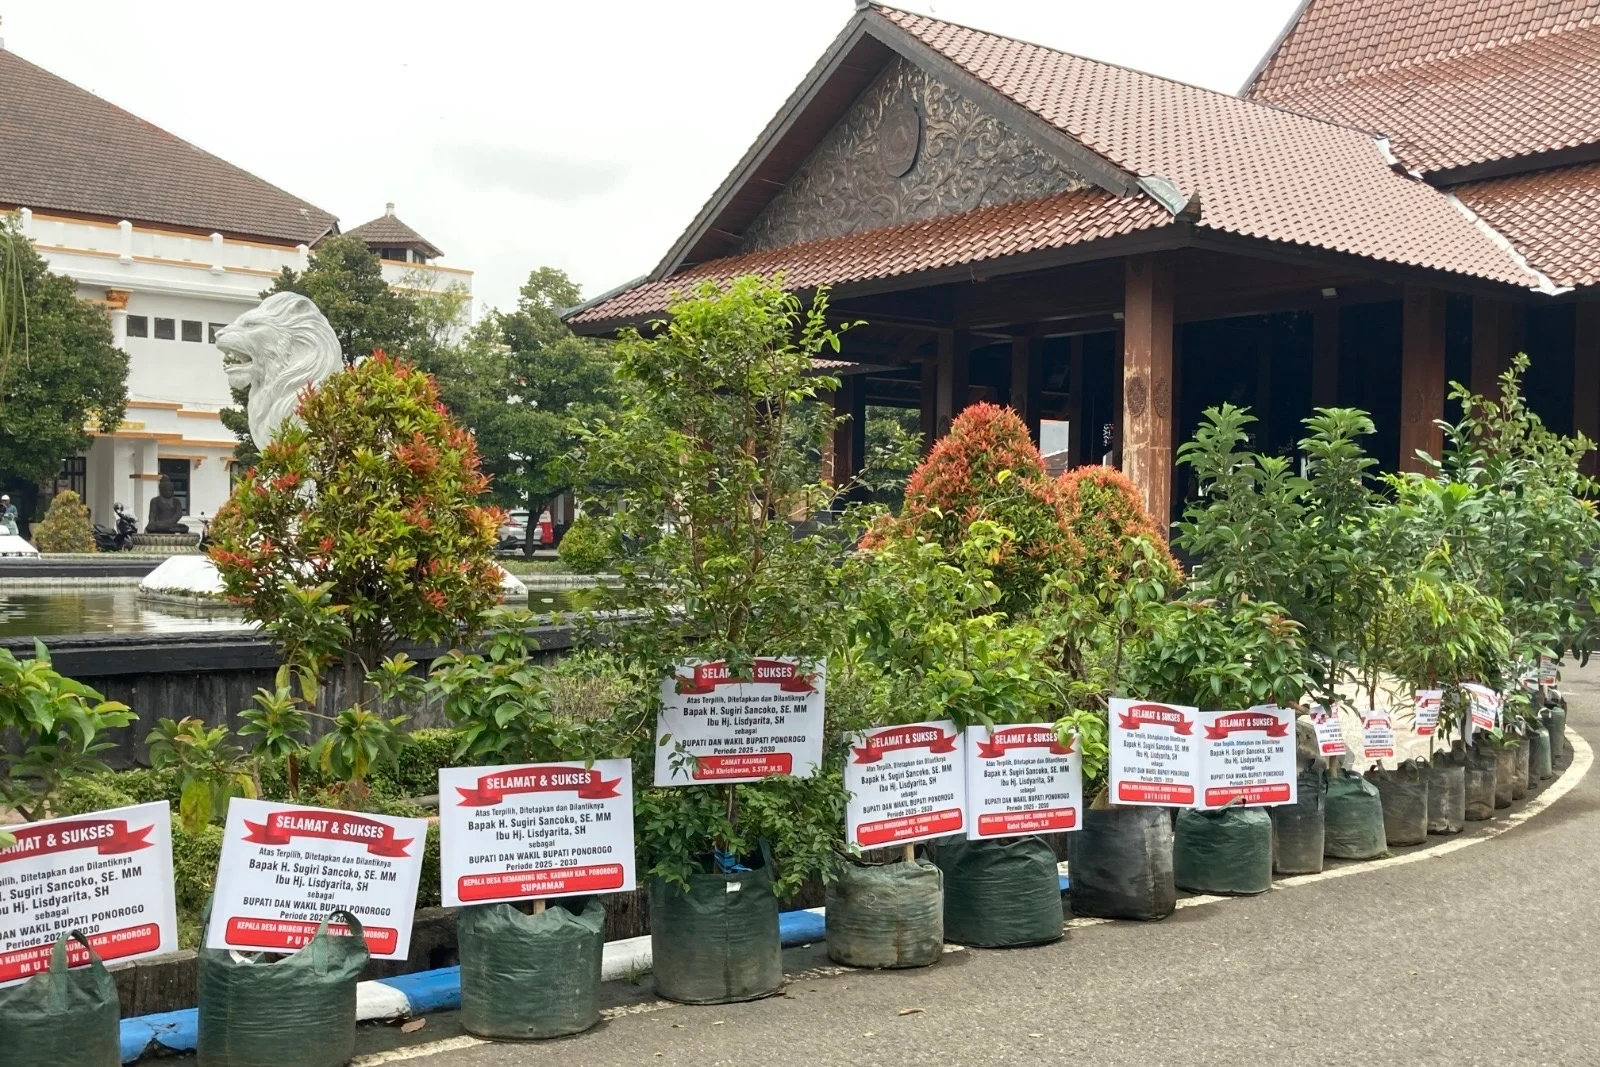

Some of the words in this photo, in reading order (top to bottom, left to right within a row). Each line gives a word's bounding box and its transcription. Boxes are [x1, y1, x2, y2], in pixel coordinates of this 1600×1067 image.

[757, 666, 792, 678] SUKSES
[701, 696, 726, 704] Terpilih,
[727, 695, 760, 703] Ditetapkan
[683, 706, 708, 717] Bapak
[710, 706, 718, 715] H.
[720, 705, 742, 717] Sugiri
[744, 705, 778, 714] Sancoko,
[780, 704, 791, 714] SE.
[793, 704, 807, 713] MM
[707, 717, 719, 726] Ibu
[721, 717, 732, 727] Hj.
[733, 716, 772, 727] Lisdyarita,
[774, 715, 785, 724] SH
[1219, 718, 1245, 728] SELAMAT
[1246, 718, 1251, 727] &
[1252, 717, 1273, 726] SUKSES
[734, 727, 757, 736] sebagai
[871, 734, 903, 748] SELAMAT
[904, 733, 910, 744] &
[912, 730, 938, 743] SUKSES
[994, 733, 1025, 744] SELAMAT
[1026, 733, 1032, 743] &
[1033, 732, 1058, 742] SUKSES
[681, 739, 706, 748] BUPATI
[723, 737, 744, 745] WAKIL
[745, 736, 769, 744] BUPATI
[770, 735, 806, 744] PONOROGO
[486, 775, 536, 789] SELAMAT
[539, 774, 548, 786] &
[551, 772, 591, 786] SUKSES
[860, 774, 879, 785] Bapak
[880, 773, 886, 781] H.
[887, 772, 905, 782] Sugiri
[905, 767, 930, 778] Sancoko,
[931, 765, 940, 774] SE.
[941, 763, 952, 772] MM
[475, 809, 490, 817] Atas
[491, 807, 518, 816] Terpilih,
[519, 805, 554, 814] Ditetapkan
[569, 802, 604, 811] Dilantiknya
[276, 815, 328, 832] SELAMAT
[330, 821, 339, 834] &
[342, 822, 384, 838] SUKSES
[468, 819, 496, 832] Bapak
[498, 819, 508, 828] H.
[510, 816, 536, 829] Sugiri
[538, 814, 577, 826] Sancoko,
[579, 813, 593, 823] SE.
[595, 812, 611, 822] MM
[46, 833, 57, 847] &
[61, 823, 114, 844] SUKSES
[496, 831, 510, 840] Ibu
[512, 829, 524, 841] Hj.
[527, 826, 572, 839] Lisdyarita,
[574, 825, 586, 835] SH
[528, 839, 555, 848] sebagai
[258, 847, 274, 856] Atas
[276, 848, 303, 860] Terpilih,
[304, 851, 341, 862] Ditetapkan
[341, 855, 354, 864] dan
[355, 856, 391, 868] Dilantiknya
[468, 854, 496, 864] BUPATI
[498, 853, 514, 862] DAN
[516, 851, 541, 860] WAKIL
[542, 848, 569, 858] BUPATI
[571, 845, 612, 856] PONOROGO
[20, 868, 66, 883] Ditetapkan
[69, 865, 84, 874] dan
[86, 856, 132, 871] Dilantiknya
[248, 858, 278, 872] Bapak
[280, 861, 290, 872] H.
[292, 862, 320, 876] Sugiri
[321, 865, 361, 879] Sancoko,
[364, 869, 377, 880] SE.
[380, 870, 396, 881] MM
[506, 862, 533, 871] Periode
[534, 860, 553, 868] 2025
[559, 858, 578, 867] 2030
[9, 884, 43, 900] Sugiri
[46, 876, 98, 893] Sancoko,
[101, 870, 118, 883] SE.
[121, 866, 142, 879] MM
[275, 874, 290, 885] Ibu
[292, 875, 305, 888] Hj.
[307, 876, 353, 892] Lisdyarita,
[356, 881, 368, 891] SH
[521, 880, 564, 892] SUPARMAN
[12, 901, 28, 914] Hj.
[32, 890, 91, 909] Lisdyarita,
[94, 885, 109, 897] SH
[307, 890, 334, 900] sebagai
[34, 906, 69, 921] sebagai
[243, 896, 272, 907] BUPATI
[274, 898, 291, 908] DAN
[293, 900, 317, 910] WAKIL
[319, 902, 348, 913] BUPATI
[348, 905, 391, 916] PONOROGO
[19, 922, 51, 936] WAKIL
[53, 914, 88, 930] BUPATI
[91, 904, 144, 922] PONOROGO
[279, 910, 308, 921] Periode
[236, 921, 260, 930] KEPALA
[5, 937, 41, 951] Periode
[92, 936, 109, 946] KAB.
[111, 927, 151, 942] PONOROGO
[4, 950, 38, 964] KAUMAN
